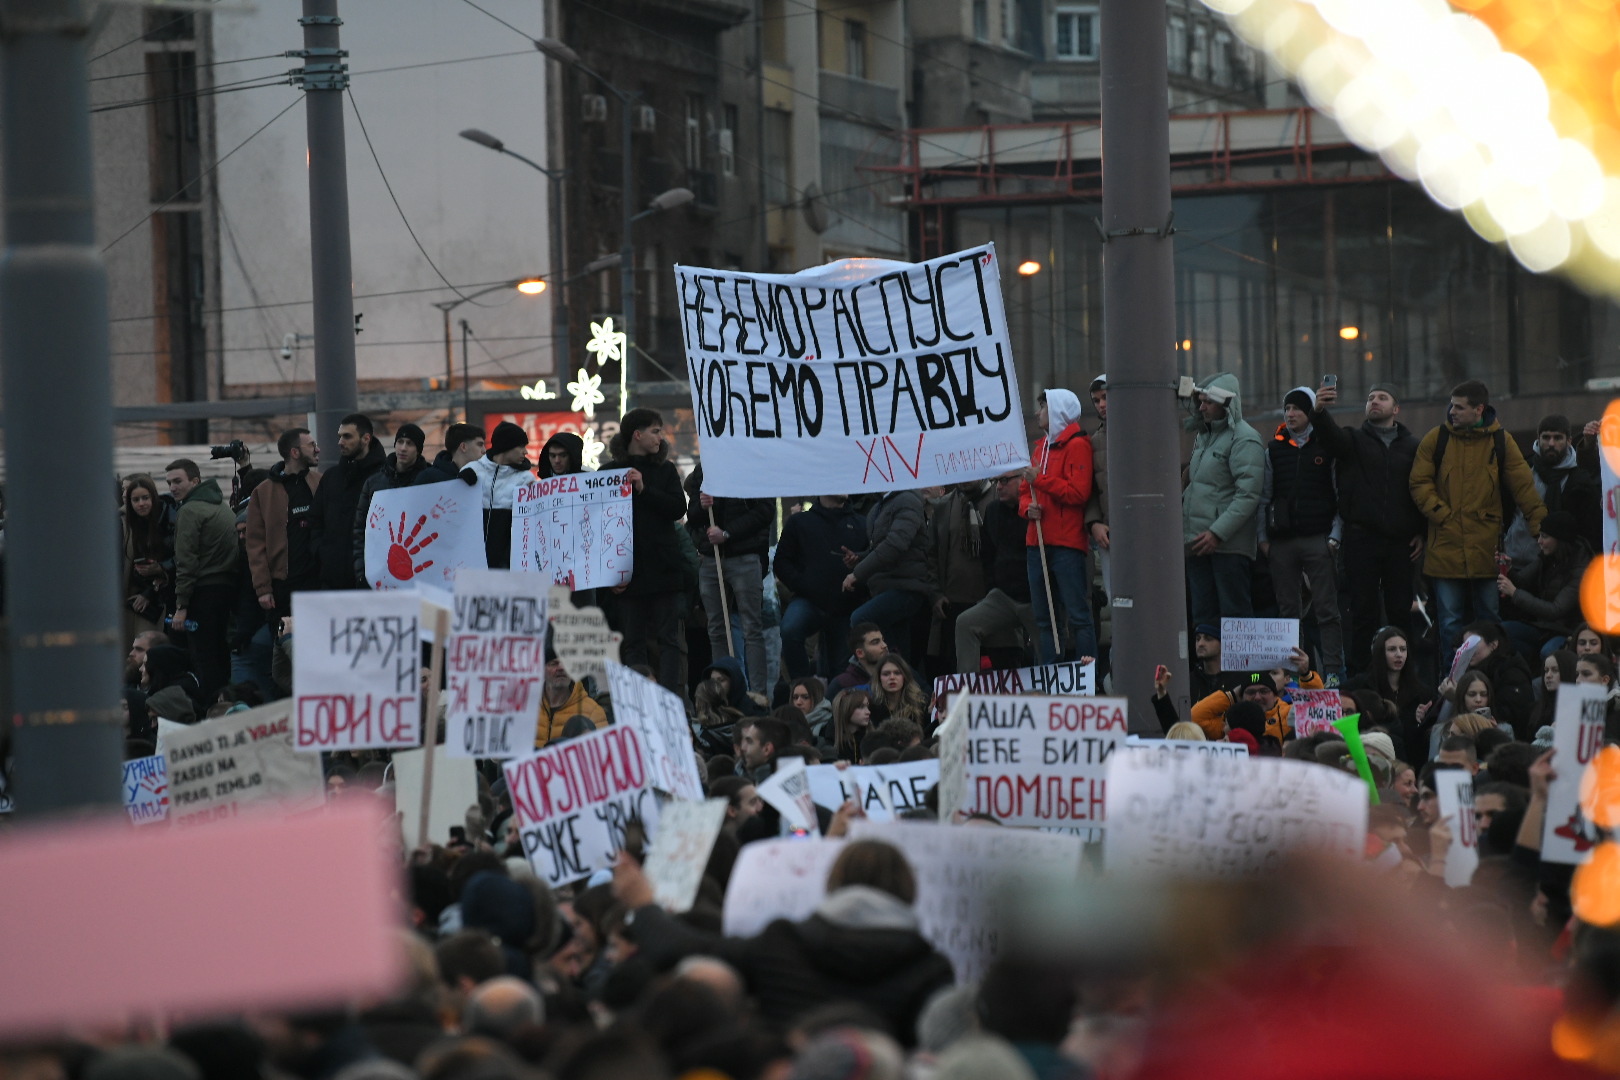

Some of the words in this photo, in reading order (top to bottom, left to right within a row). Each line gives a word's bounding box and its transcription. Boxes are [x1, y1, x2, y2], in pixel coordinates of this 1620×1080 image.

[681, 272, 806, 359] НЕЋЕМО
[690, 357, 824, 439] ХОЋЕМО
[834, 342, 1011, 436] ПРАВДУ
[517, 476, 580, 502] РАСПОРЕД
[1030, 663, 1087, 696] НИЈЕ
[298, 693, 371, 748] БОРИ
[379, 696, 417, 744] СЕ
[1049, 702, 1128, 733] БОРБА
[1308, 706, 1324, 720] АКО
[1326, 709, 1337, 721] НЕ
[170, 739, 214, 764] DAVNO
[1043, 736, 1116, 765] БИТИ
[958, 773, 1107, 821] ЛОМЉЕН
[524, 814, 591, 882] РУКЕ
